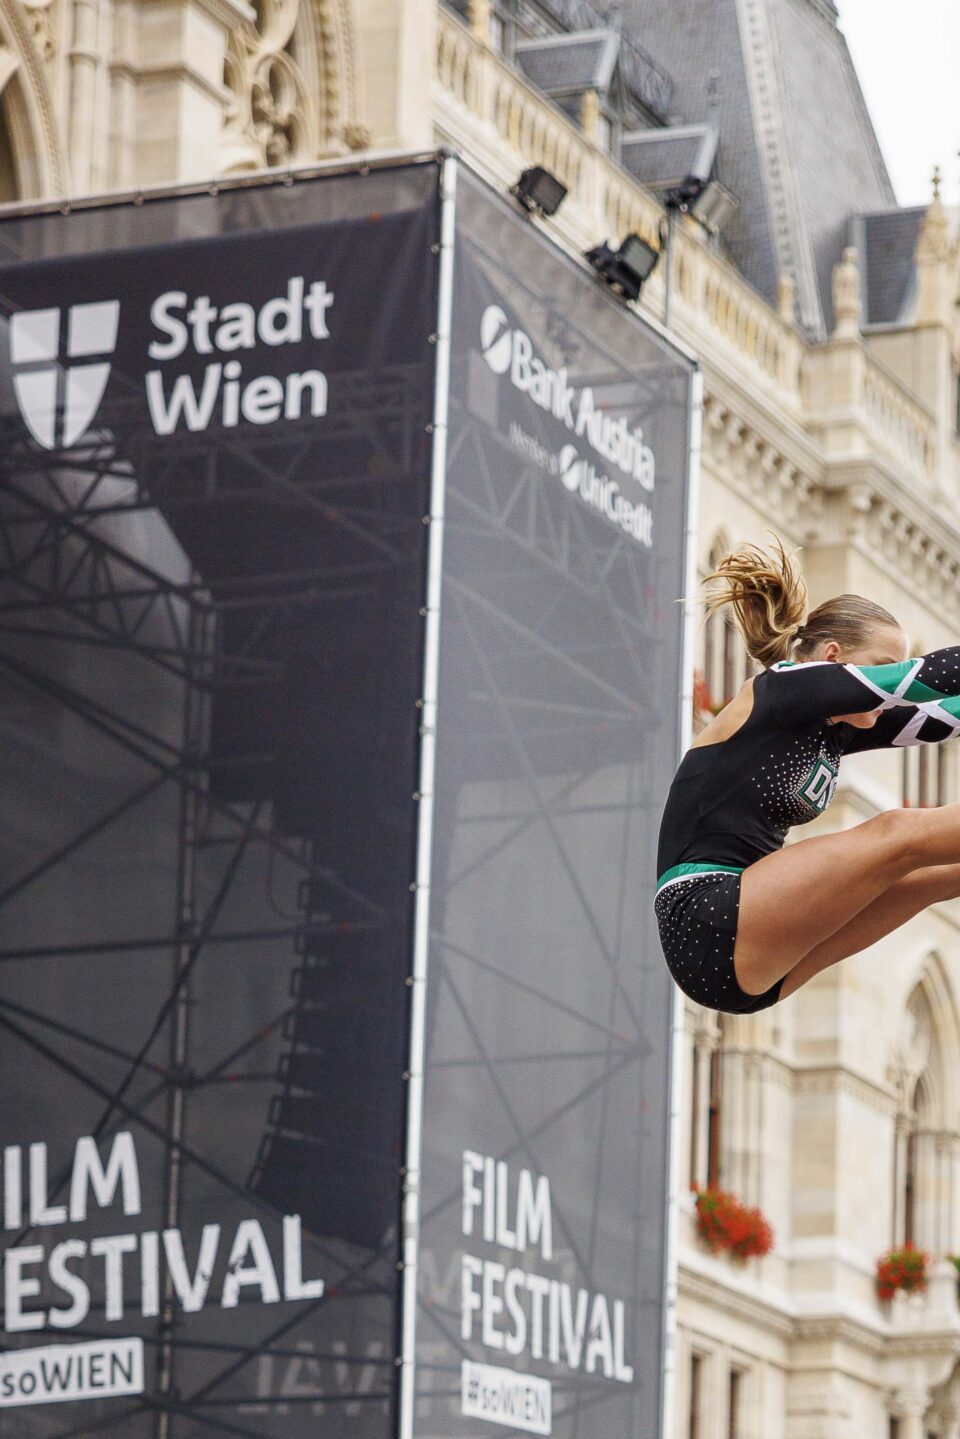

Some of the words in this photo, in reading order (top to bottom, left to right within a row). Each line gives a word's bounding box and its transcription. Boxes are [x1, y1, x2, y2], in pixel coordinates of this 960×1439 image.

[148, 276, 335, 361] Stadt
[145, 360, 328, 436] Wien
[511, 329, 575, 431] Bank
[575, 387, 656, 492] Austria
[580, 460, 653, 548] UniCredit
[3, 1130, 142, 1230] ILM
[462, 1150, 553, 1261] FILM
[3, 1213, 325, 1333] ESTIVAL
[461, 1254, 634, 1383] FESTIVAL
[1, 1349, 134, 1397] soWIEN
[467, 1377, 548, 1424] #soWIEN
